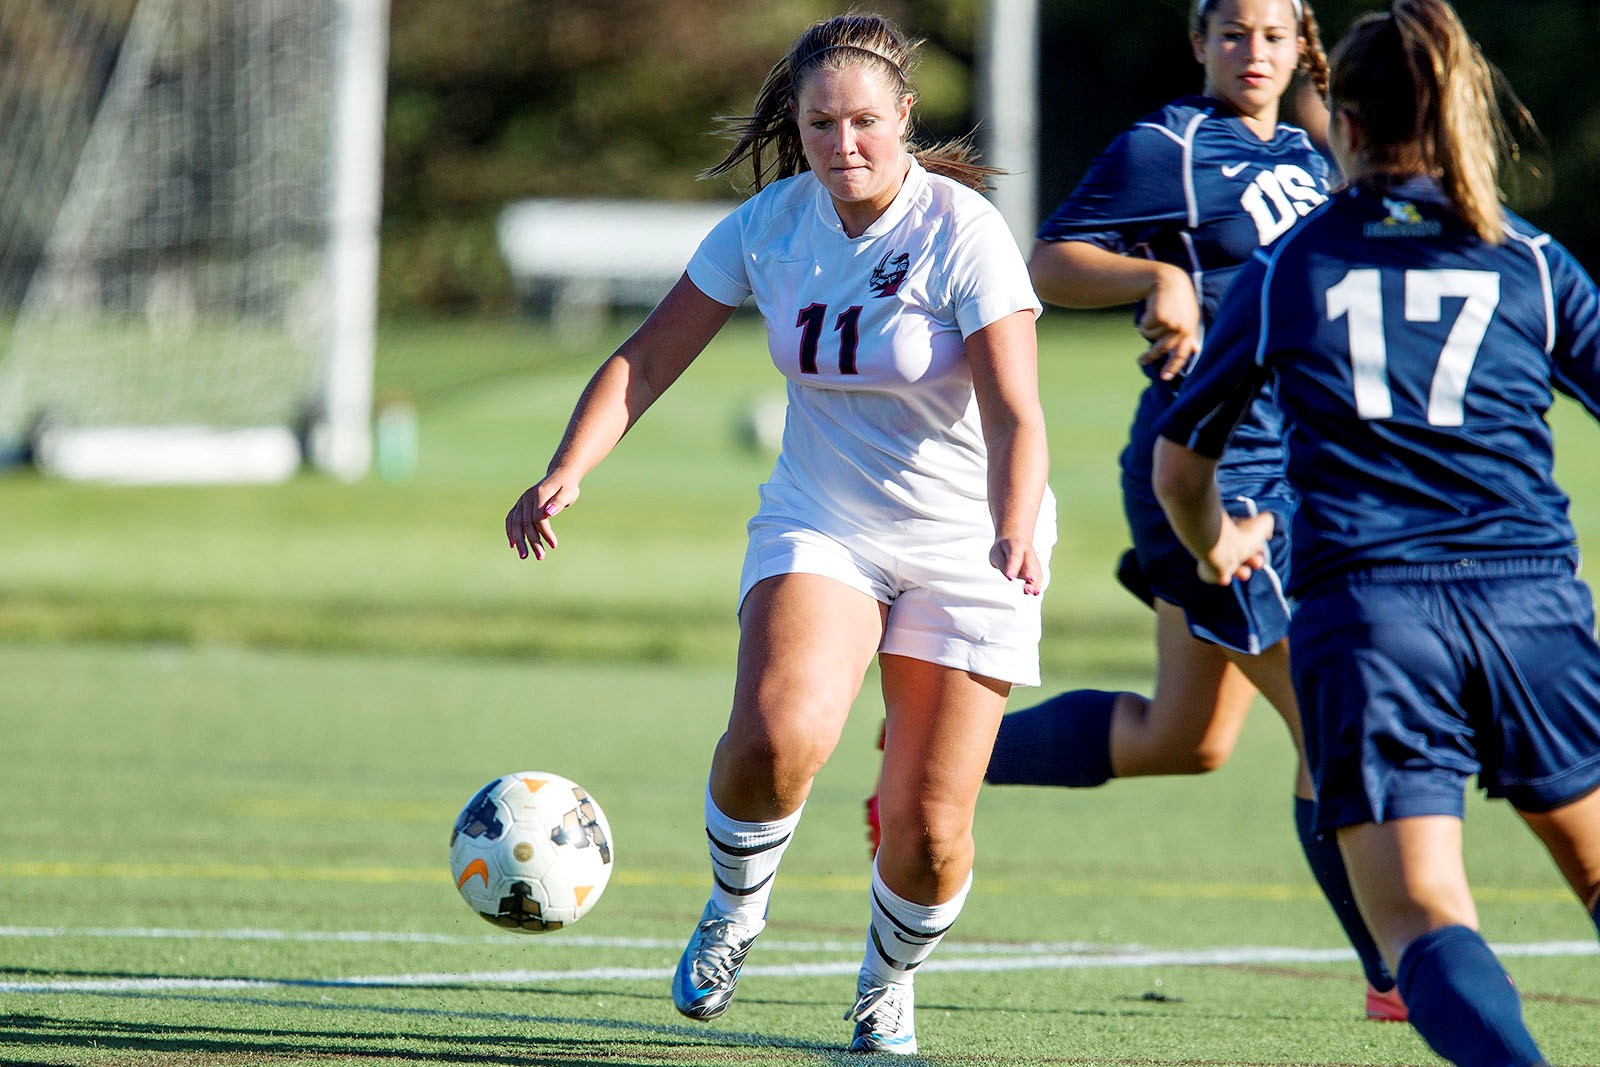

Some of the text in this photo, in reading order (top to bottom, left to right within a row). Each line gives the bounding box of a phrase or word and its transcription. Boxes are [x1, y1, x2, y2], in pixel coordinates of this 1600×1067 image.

[1240, 164, 1330, 246] US
[795, 302, 864, 375] 11
[1326, 268, 1500, 427] 17
